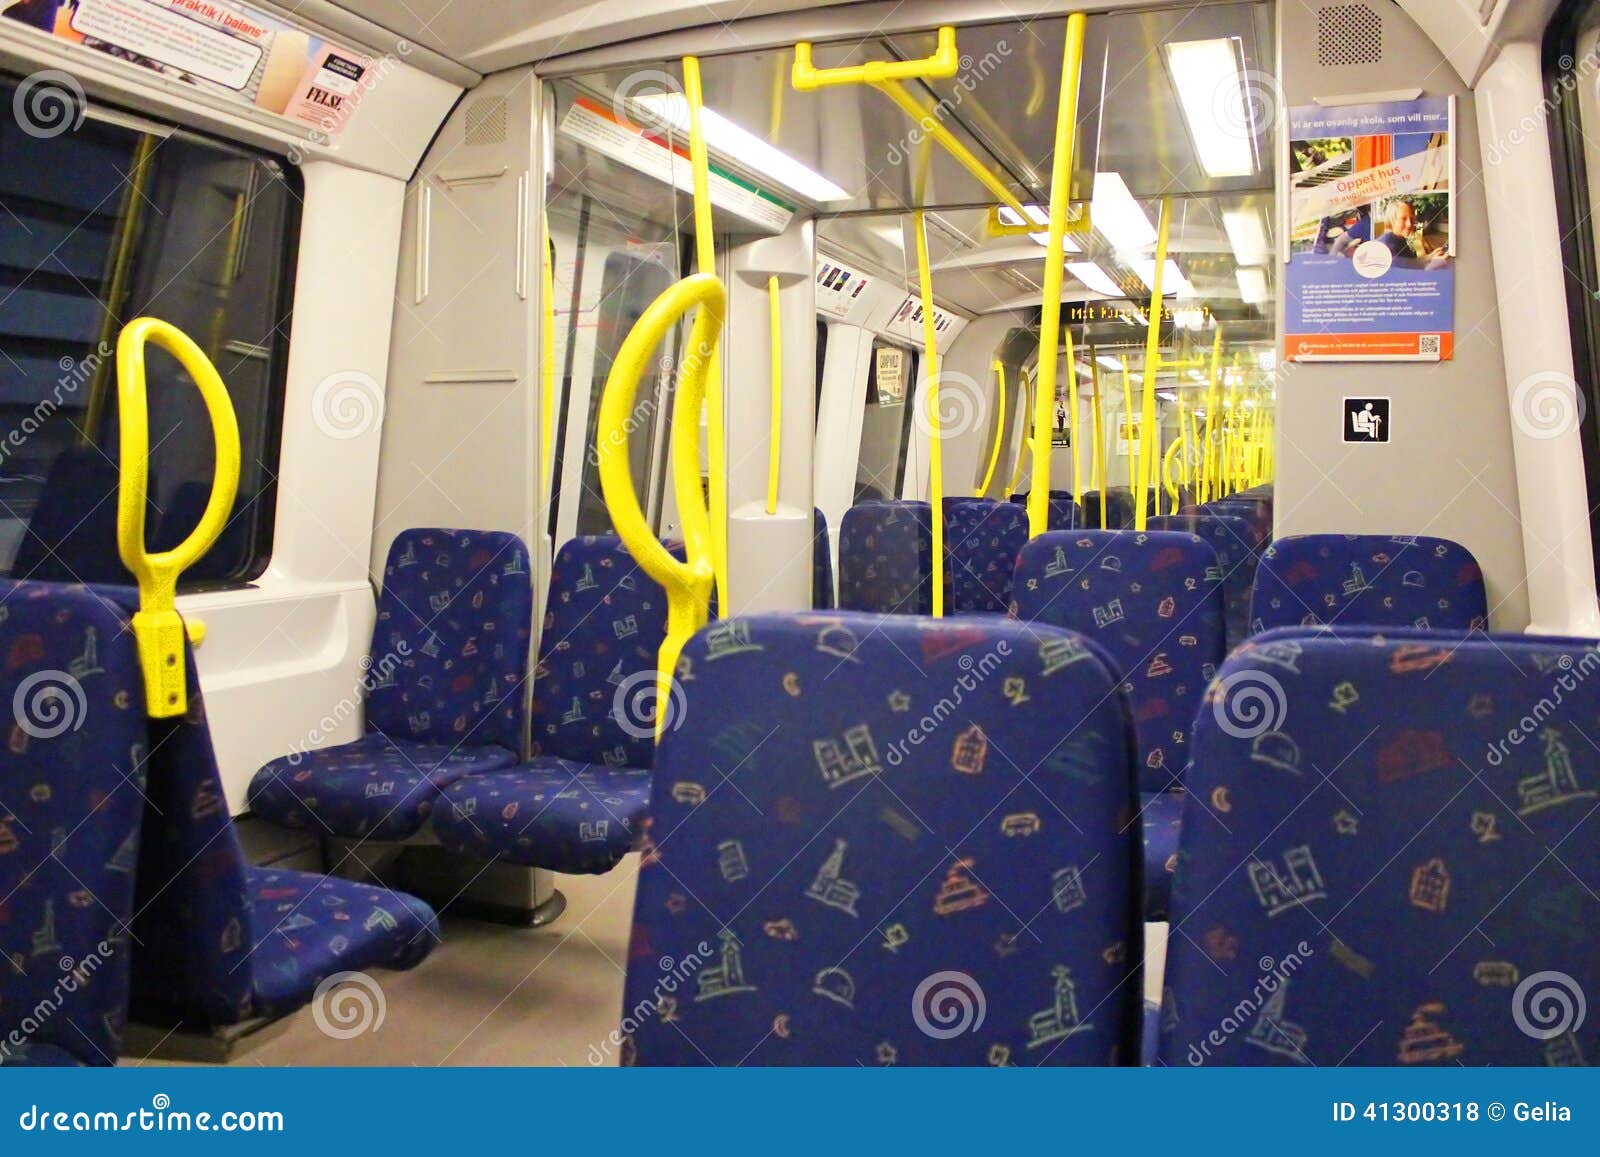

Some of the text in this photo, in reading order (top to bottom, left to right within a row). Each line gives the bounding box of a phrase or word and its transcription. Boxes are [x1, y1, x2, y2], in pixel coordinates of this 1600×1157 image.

[1387, 113, 1406, 123] som
[1407, 112, 1422, 122] vill
[1378, 166, 1401, 179] hus
